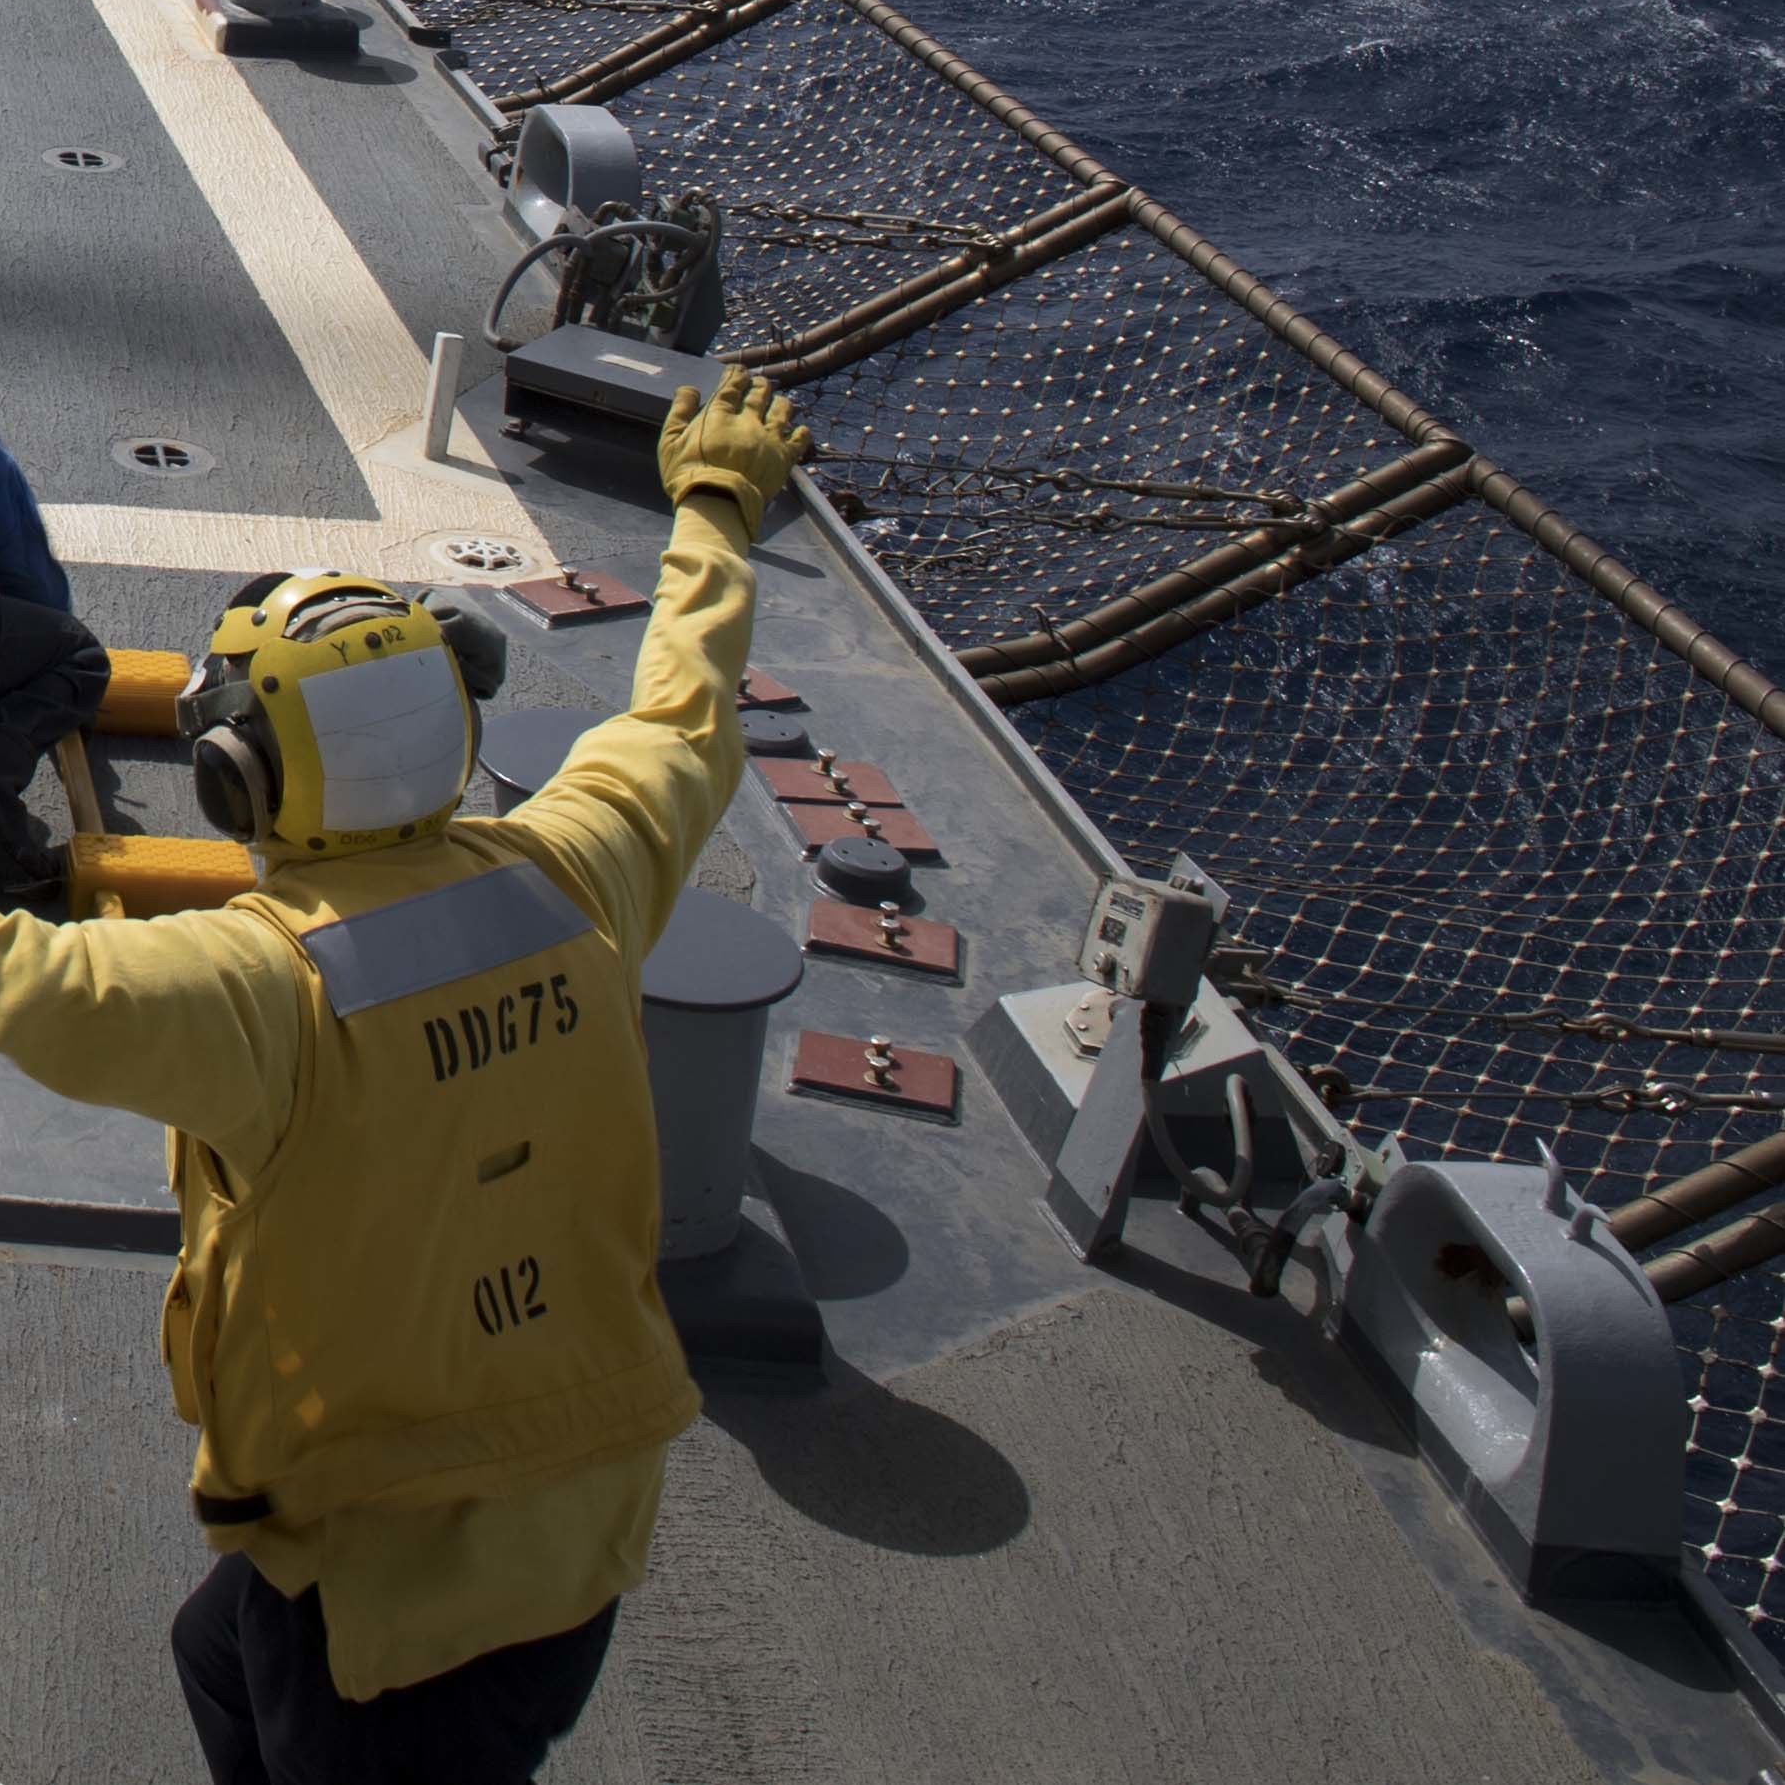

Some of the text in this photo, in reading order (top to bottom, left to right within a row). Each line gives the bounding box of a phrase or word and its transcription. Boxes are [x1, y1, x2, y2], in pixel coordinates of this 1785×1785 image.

[330, 640, 349, 665] Y
[423, 973, 579, 1082] DDG75
[473, 1255, 547, 1336] 012
